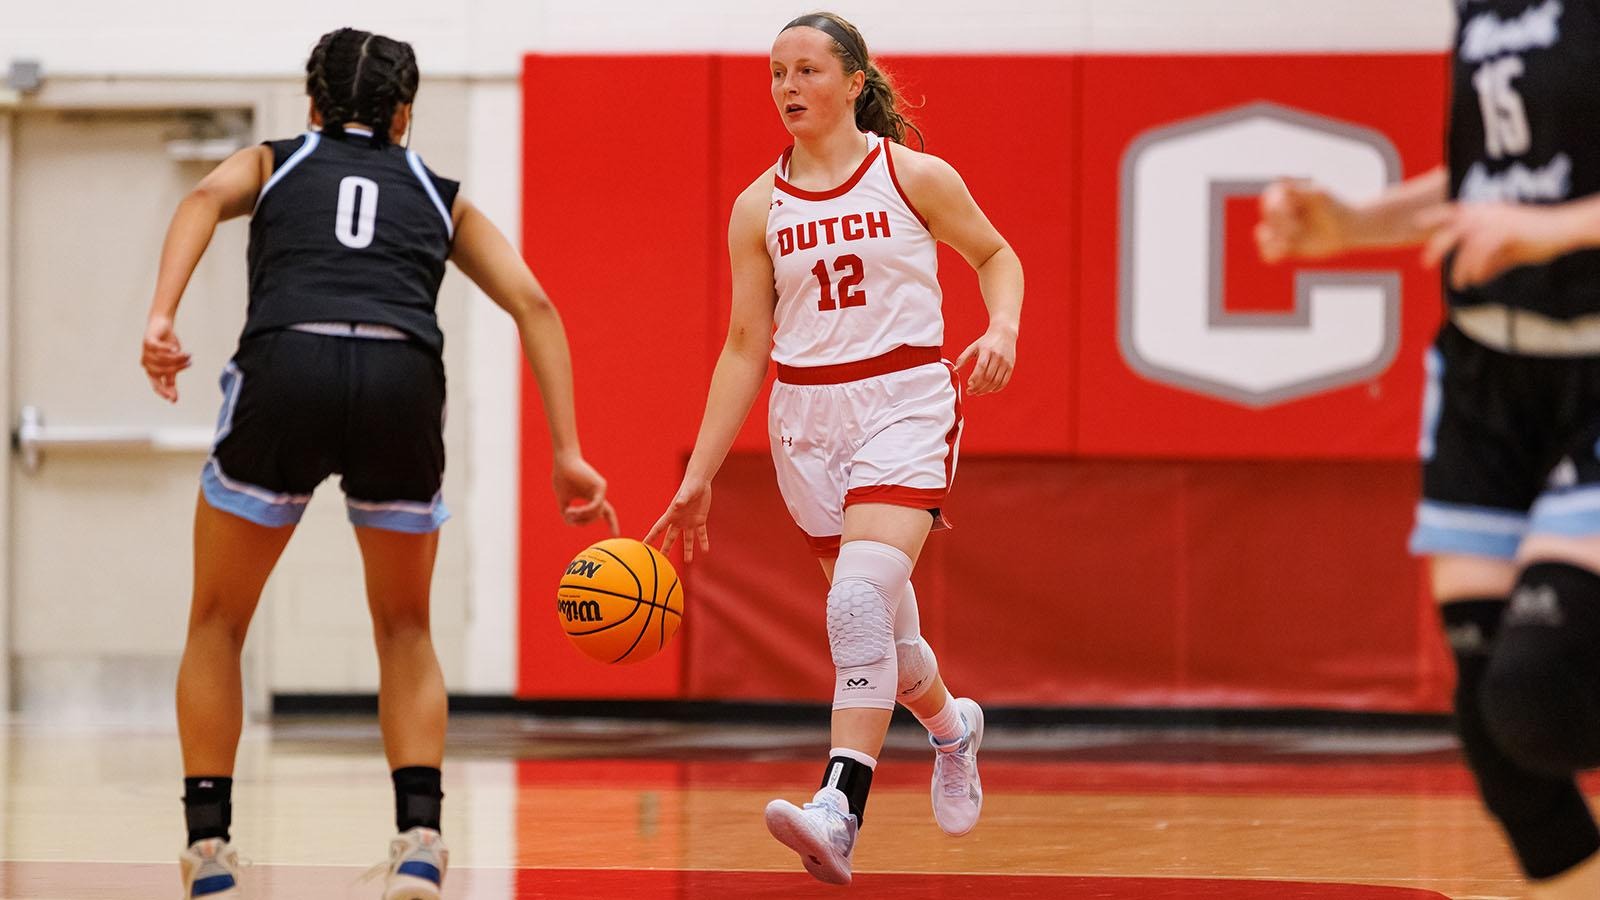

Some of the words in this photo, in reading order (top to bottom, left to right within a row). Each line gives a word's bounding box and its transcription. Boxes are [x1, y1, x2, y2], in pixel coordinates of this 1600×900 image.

[1472, 56, 1530, 158] 15
[335, 175, 379, 249] 0
[777, 211, 891, 257] DUTCH
[811, 253, 867, 312] 12
